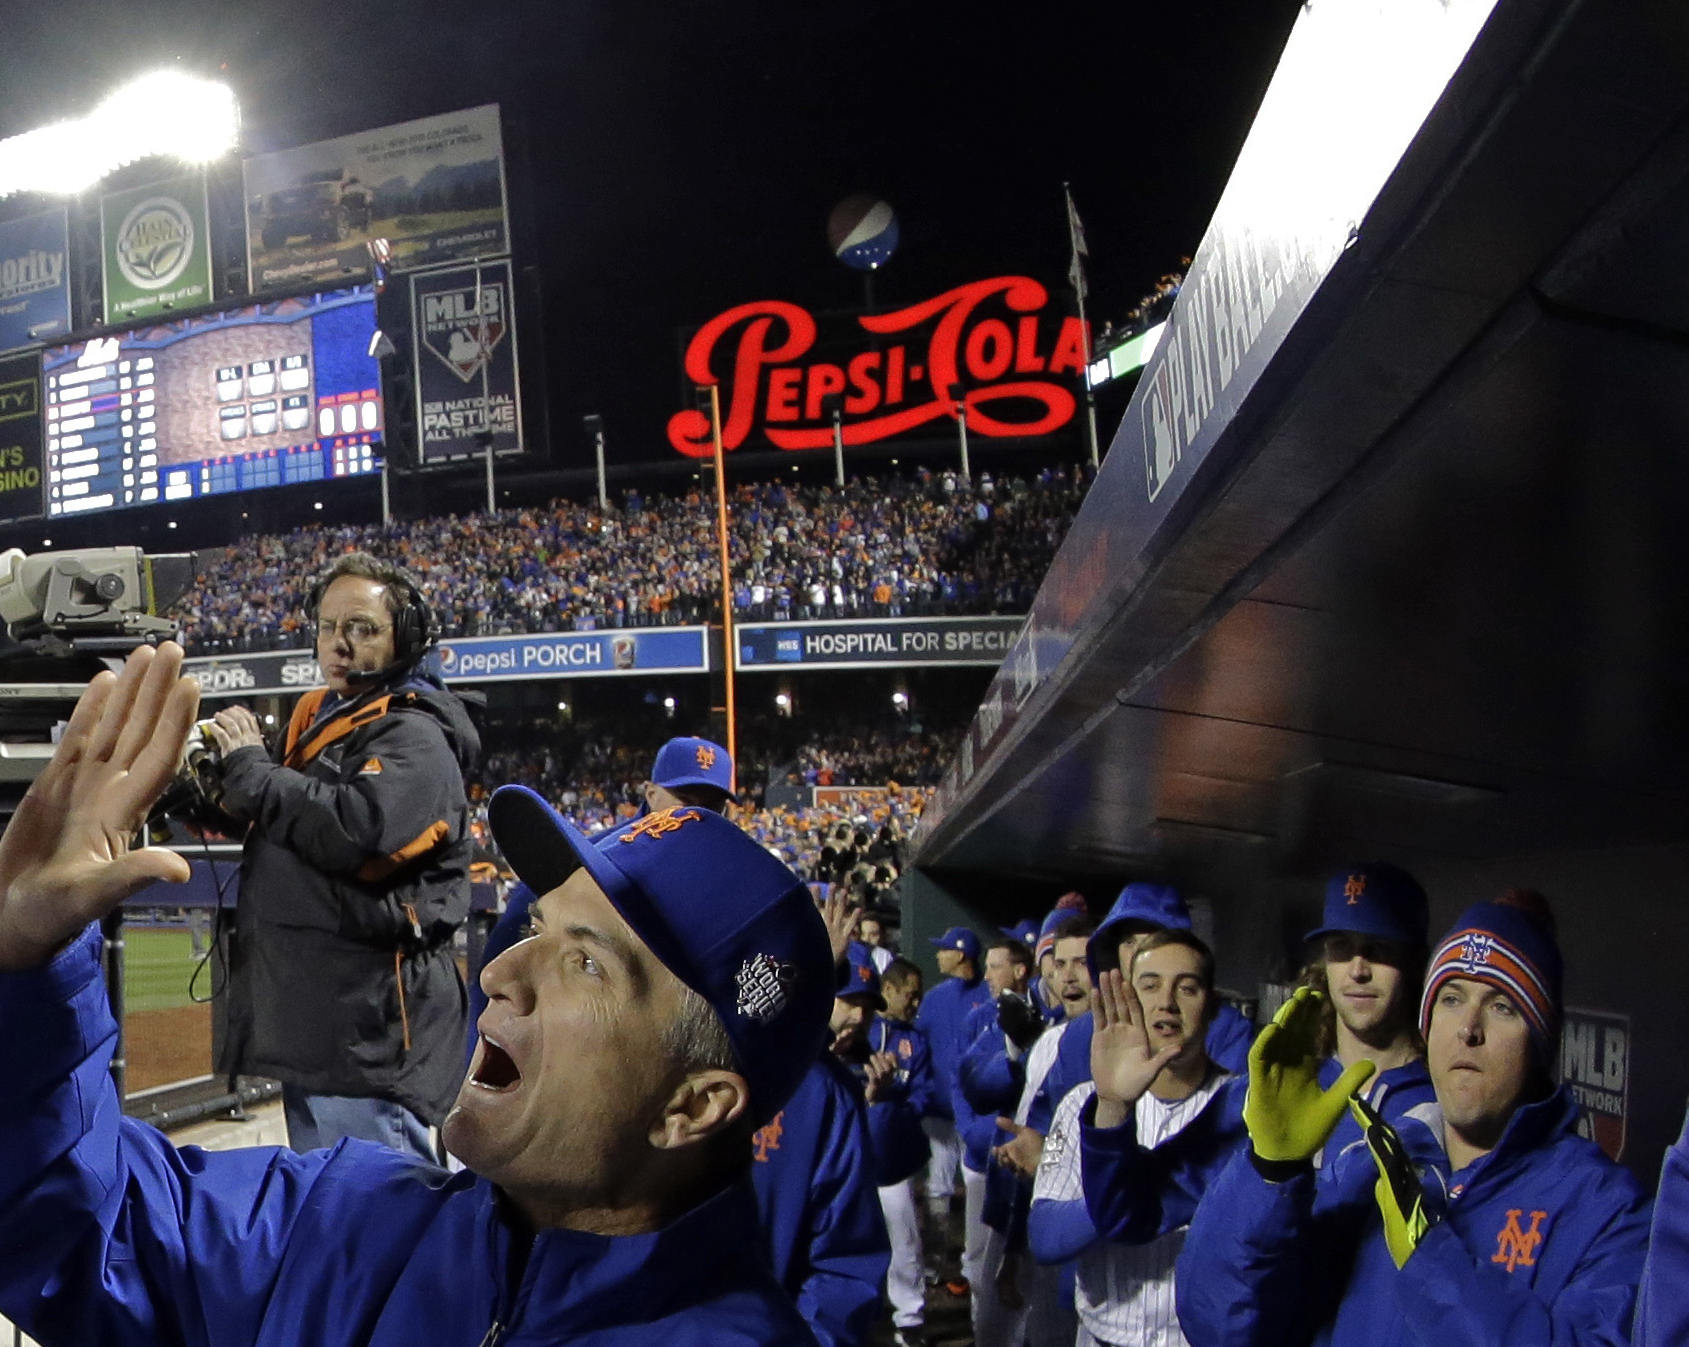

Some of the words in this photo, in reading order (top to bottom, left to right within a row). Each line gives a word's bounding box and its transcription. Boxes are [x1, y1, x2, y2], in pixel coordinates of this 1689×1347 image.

[426, 288, 500, 324] MLB
[425, 430, 451, 442] ALL
[459, 645, 517, 676] pepsi
[523, 643, 601, 669] PORCH
[806, 632, 898, 655] HOSPITAL
[902, 631, 939, 651] FOR
[1563, 1017, 1626, 1092] MLB
